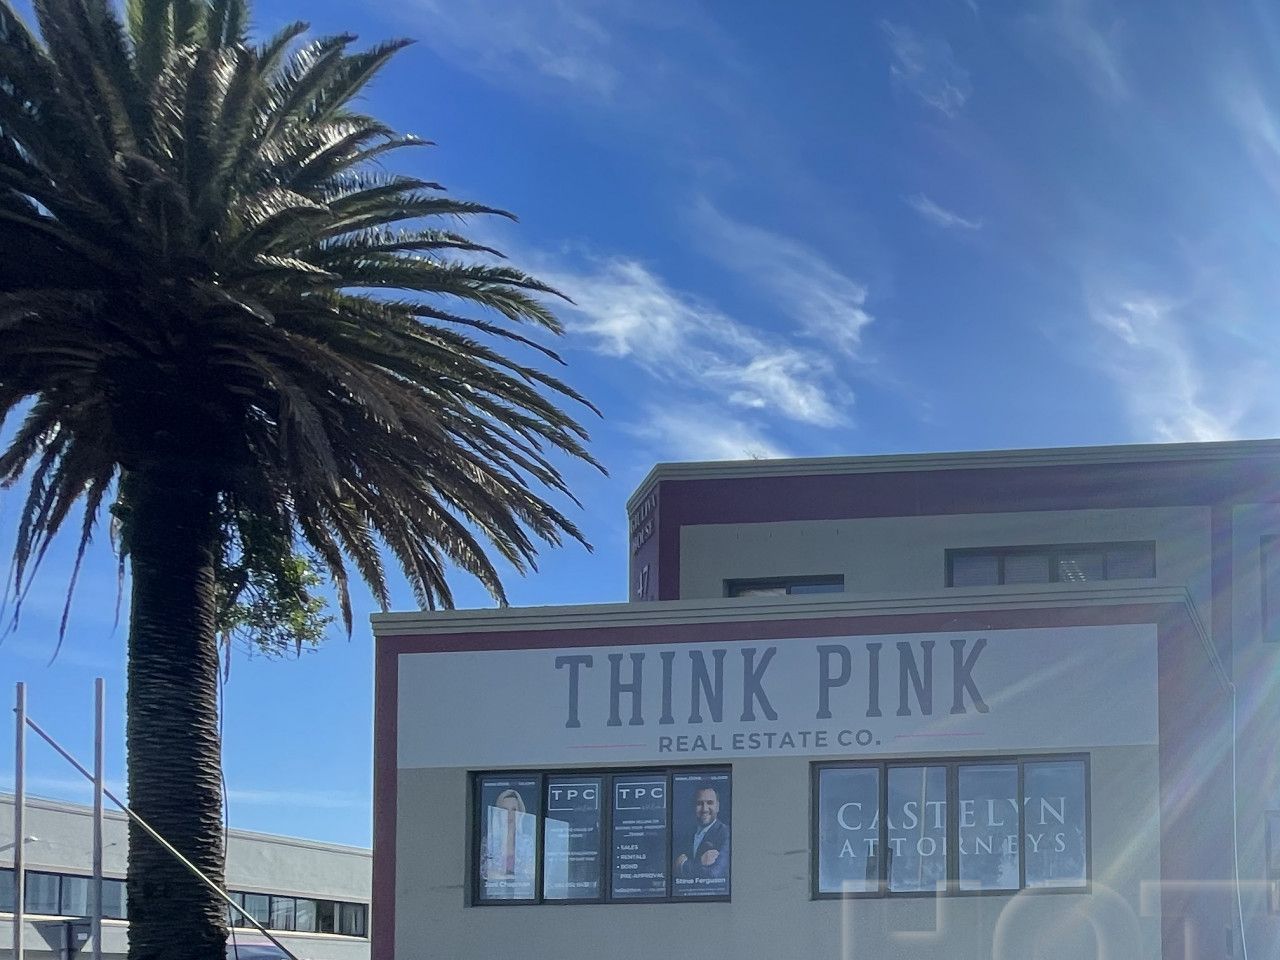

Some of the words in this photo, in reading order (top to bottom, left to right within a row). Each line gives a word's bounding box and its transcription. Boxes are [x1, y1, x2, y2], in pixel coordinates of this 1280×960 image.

[554, 646, 779, 729] THINK
[815, 637, 990, 720] PINK
[658, 735, 723, 753] REAL
[732, 731, 828, 750] ESTATE
[837, 729, 882, 748] CO.
[552, 789, 595, 801] TPC
[619, 788, 663, 799] TPC
[837, 796, 1067, 831] CASTELYN
[838, 832, 1066, 858] ATTORNEYS
